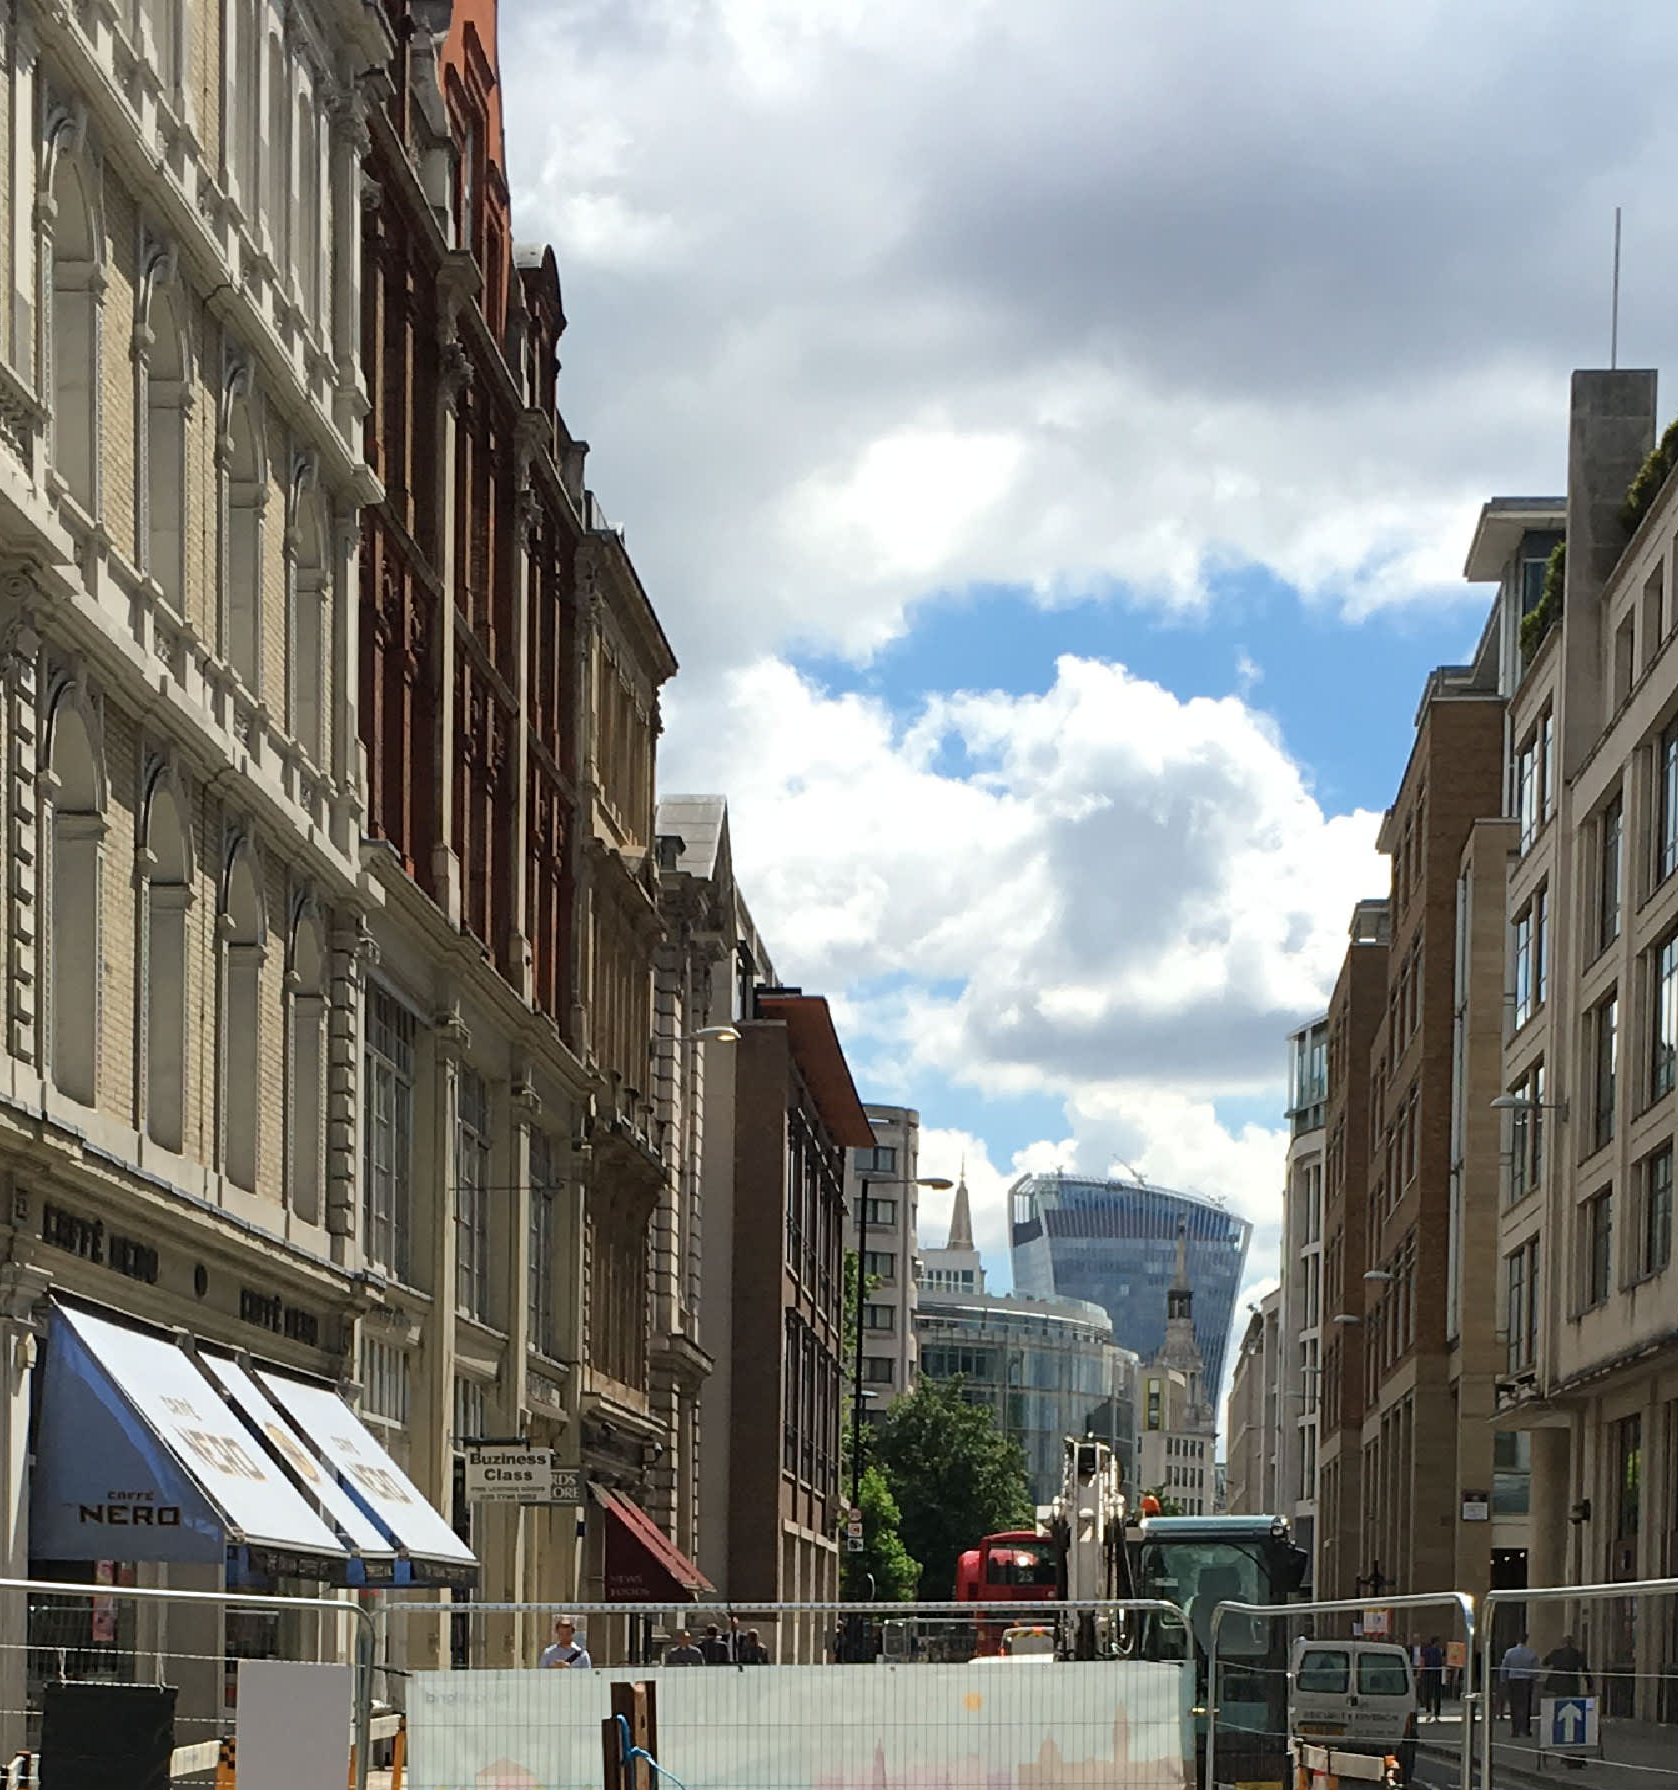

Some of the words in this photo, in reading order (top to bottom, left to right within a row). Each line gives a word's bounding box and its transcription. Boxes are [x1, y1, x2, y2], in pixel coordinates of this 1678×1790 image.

[470, 1453, 546, 1465] Buziness
[484, 1468, 533, 1481] Class
[79, 1504, 181, 1526] NERO
